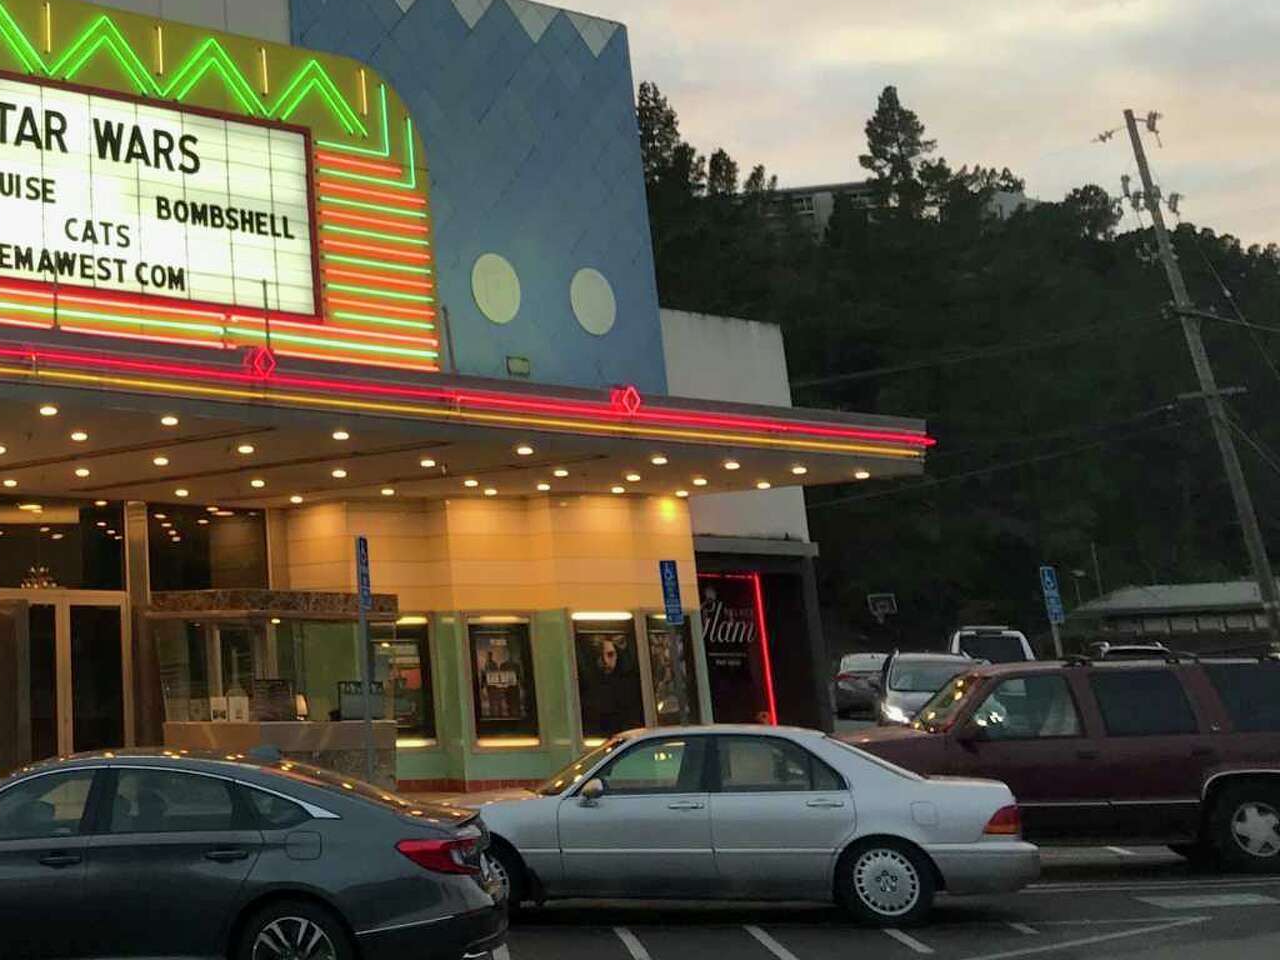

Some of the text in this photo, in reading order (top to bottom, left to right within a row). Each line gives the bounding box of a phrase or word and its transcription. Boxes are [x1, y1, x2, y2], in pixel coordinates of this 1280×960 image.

[93, 117, 201, 175] WARS
[64, 217, 130, 248] CATS
[155, 196, 296, 240] BOMBSHELL
